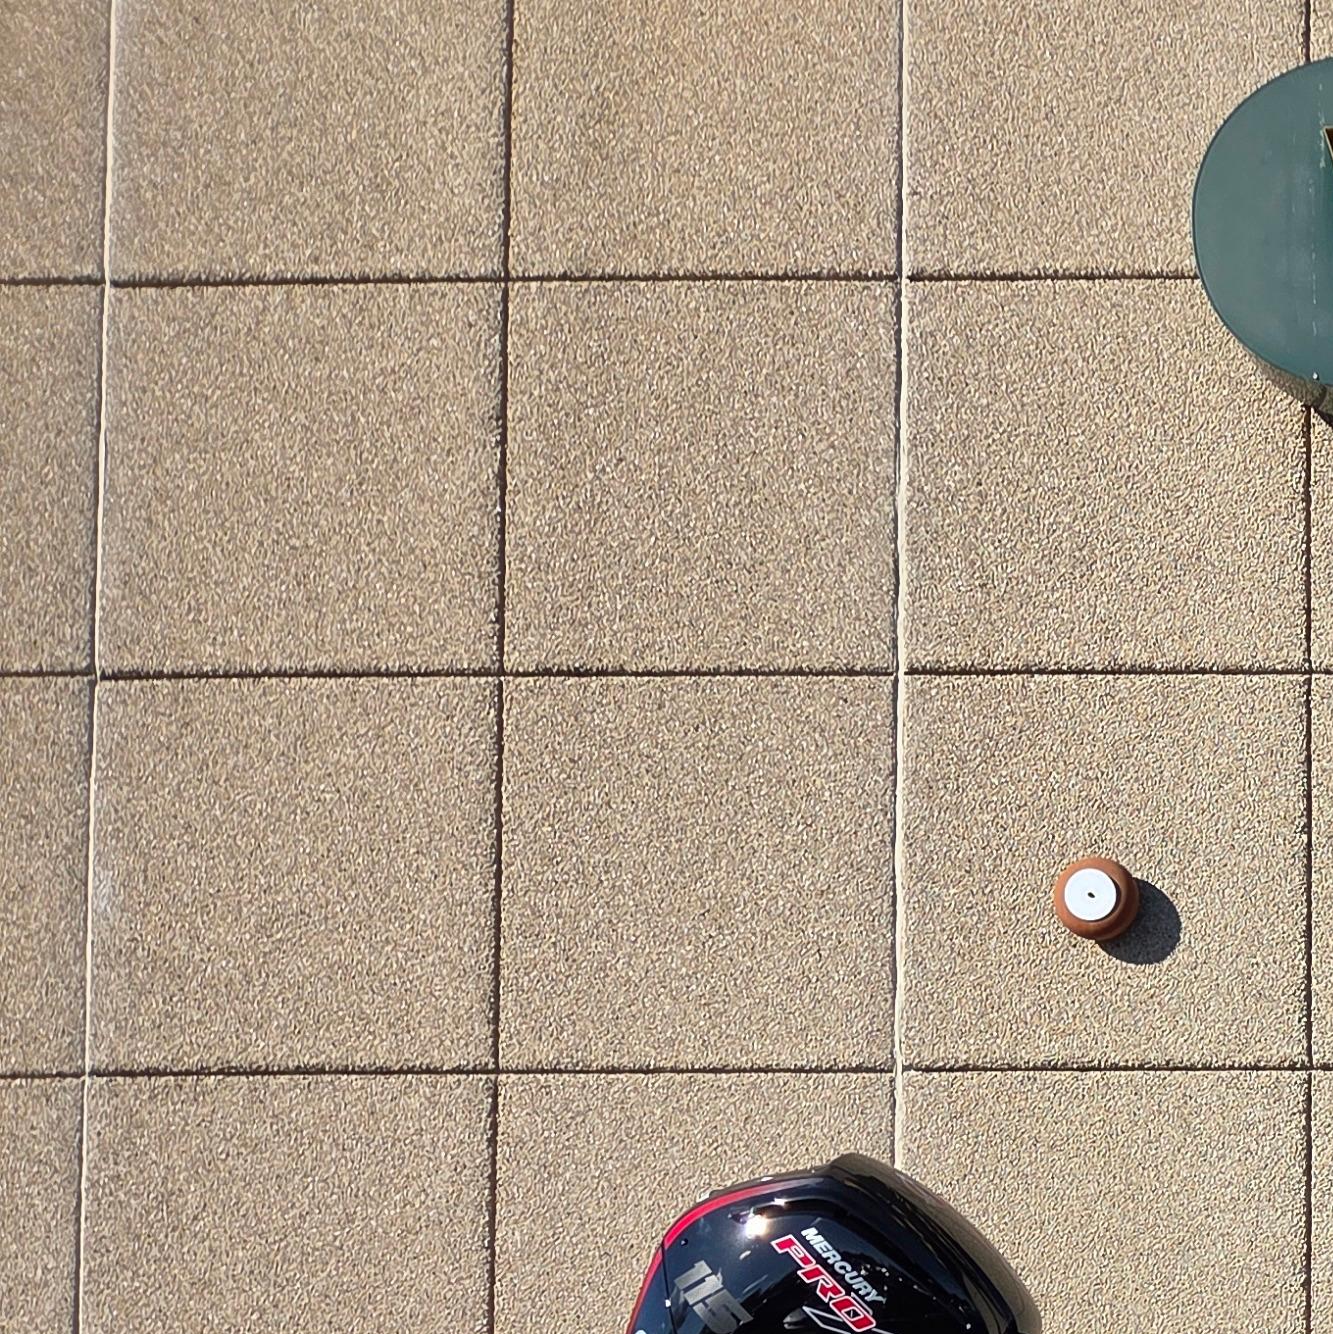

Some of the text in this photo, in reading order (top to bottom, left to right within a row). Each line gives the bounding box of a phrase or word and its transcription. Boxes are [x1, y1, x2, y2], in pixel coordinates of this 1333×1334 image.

[674, 1260, 754, 1334] 115
[769, 1233, 877, 1333] PRO
[800, 1226, 888, 1305] MERCURY
